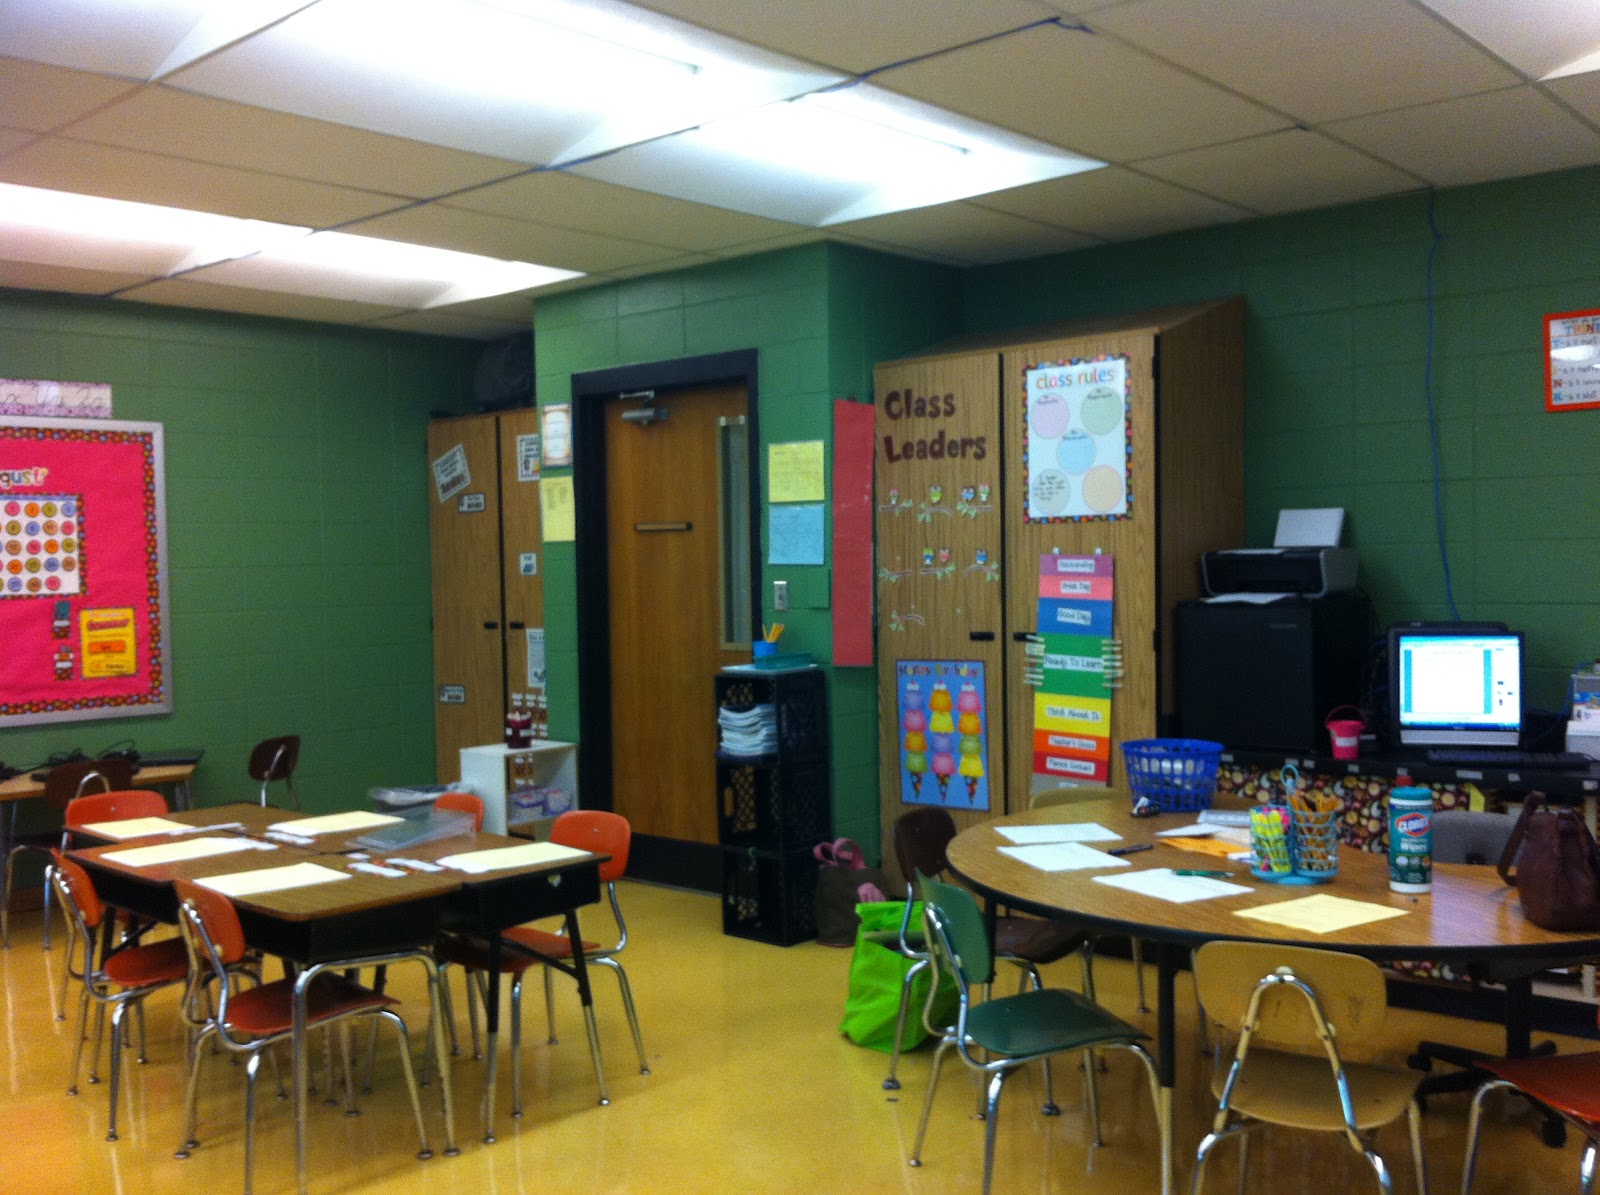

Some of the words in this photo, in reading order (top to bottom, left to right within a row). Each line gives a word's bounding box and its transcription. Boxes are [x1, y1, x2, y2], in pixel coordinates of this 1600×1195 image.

[1036, 373, 1073, 390] class
[1078, 367, 1115, 385] rules
[884, 388, 956, 421] Class
[884, 429, 987, 463] Leaders
[1070, 657, 1080, 666] To
